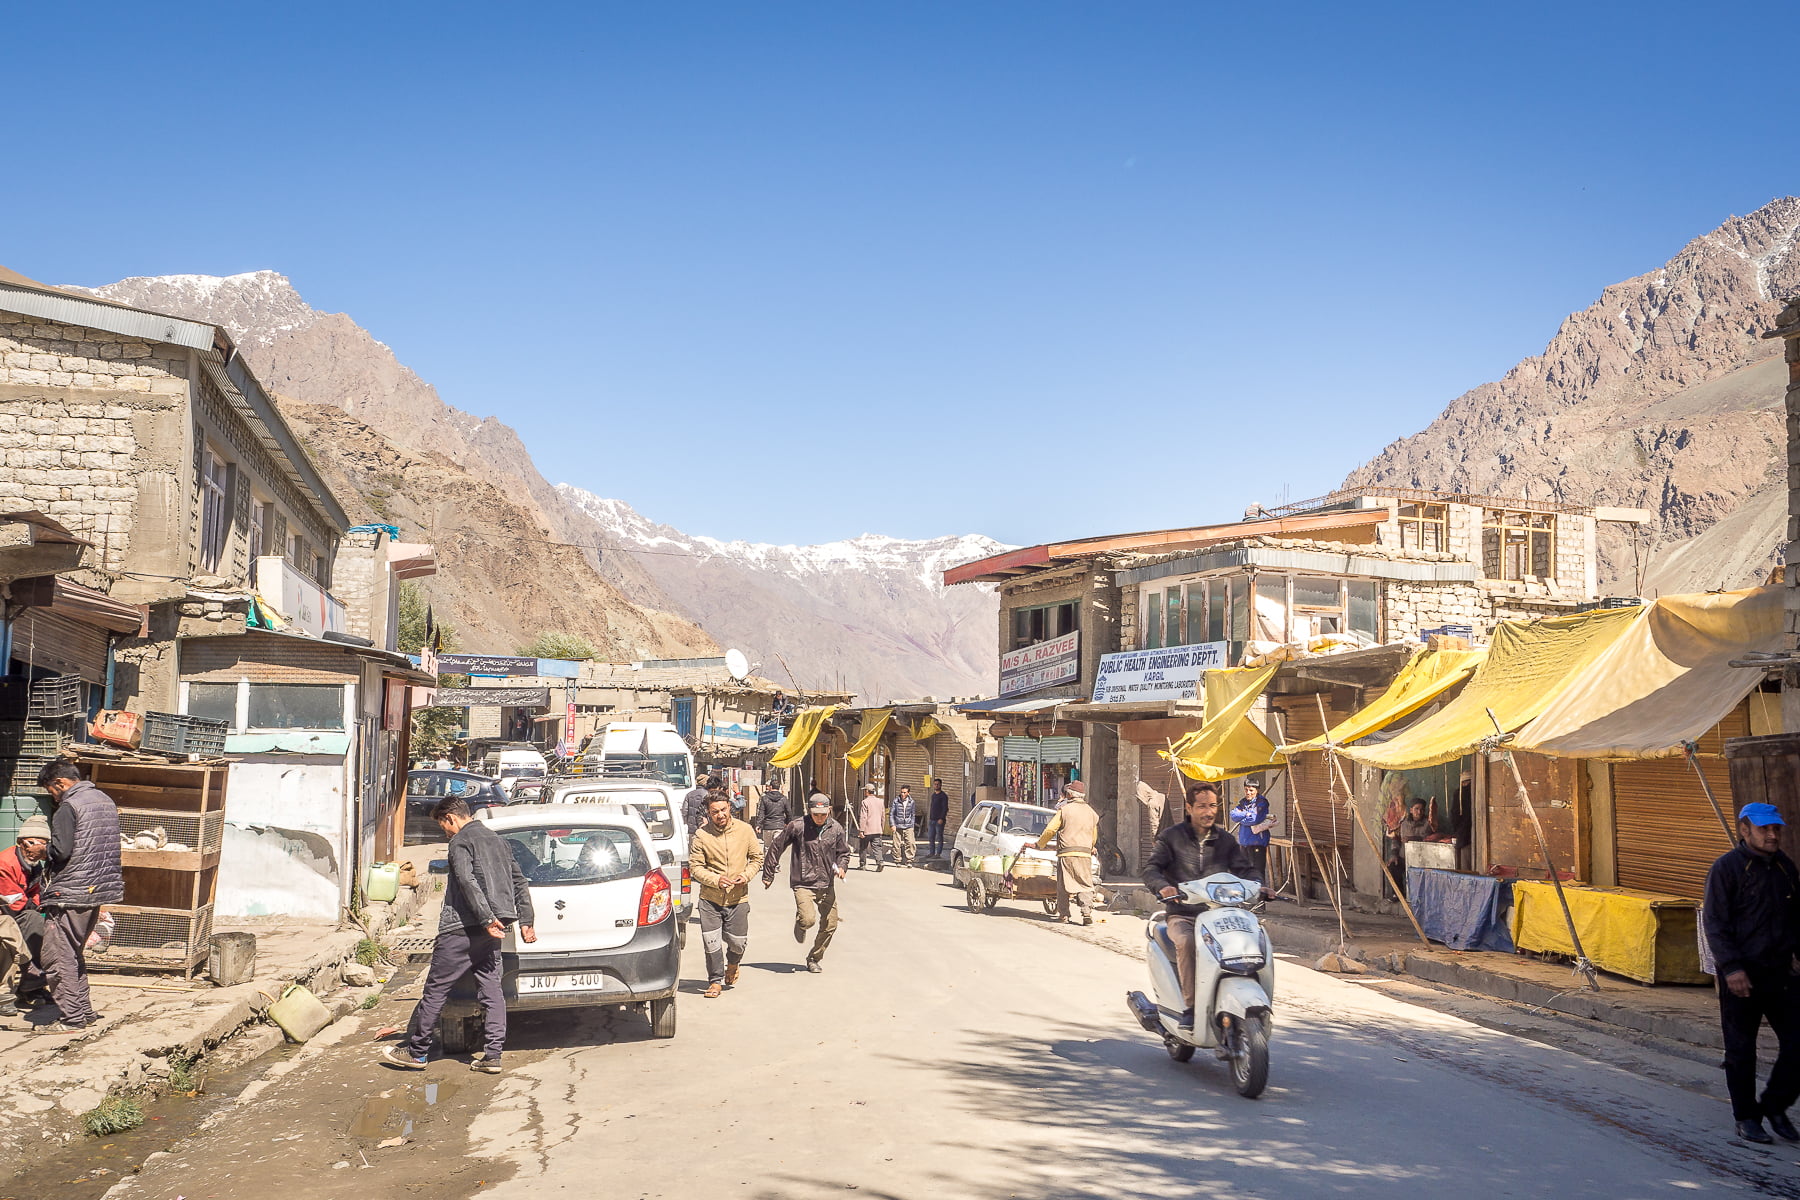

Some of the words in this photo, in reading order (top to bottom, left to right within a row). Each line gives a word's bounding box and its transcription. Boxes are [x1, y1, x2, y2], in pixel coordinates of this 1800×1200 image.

[1002, 655, 1019, 670] M/S
[1021, 652, 1032, 664] A.
[1036, 638, 1075, 661] RAZVEE
[1100, 660, 1122, 674] PUBLIC
[1123, 657, 1147, 672] HEALTH
[1148, 653, 1190, 669] ENGINEERING
[1191, 650, 1219, 666] DEPTT.
[1143, 671, 1165, 682] KARGIL
[1140, 682, 1153, 692] QUALITY
[530, 976, 558, 988] JK07
[571, 974, 600, 986] 5400
